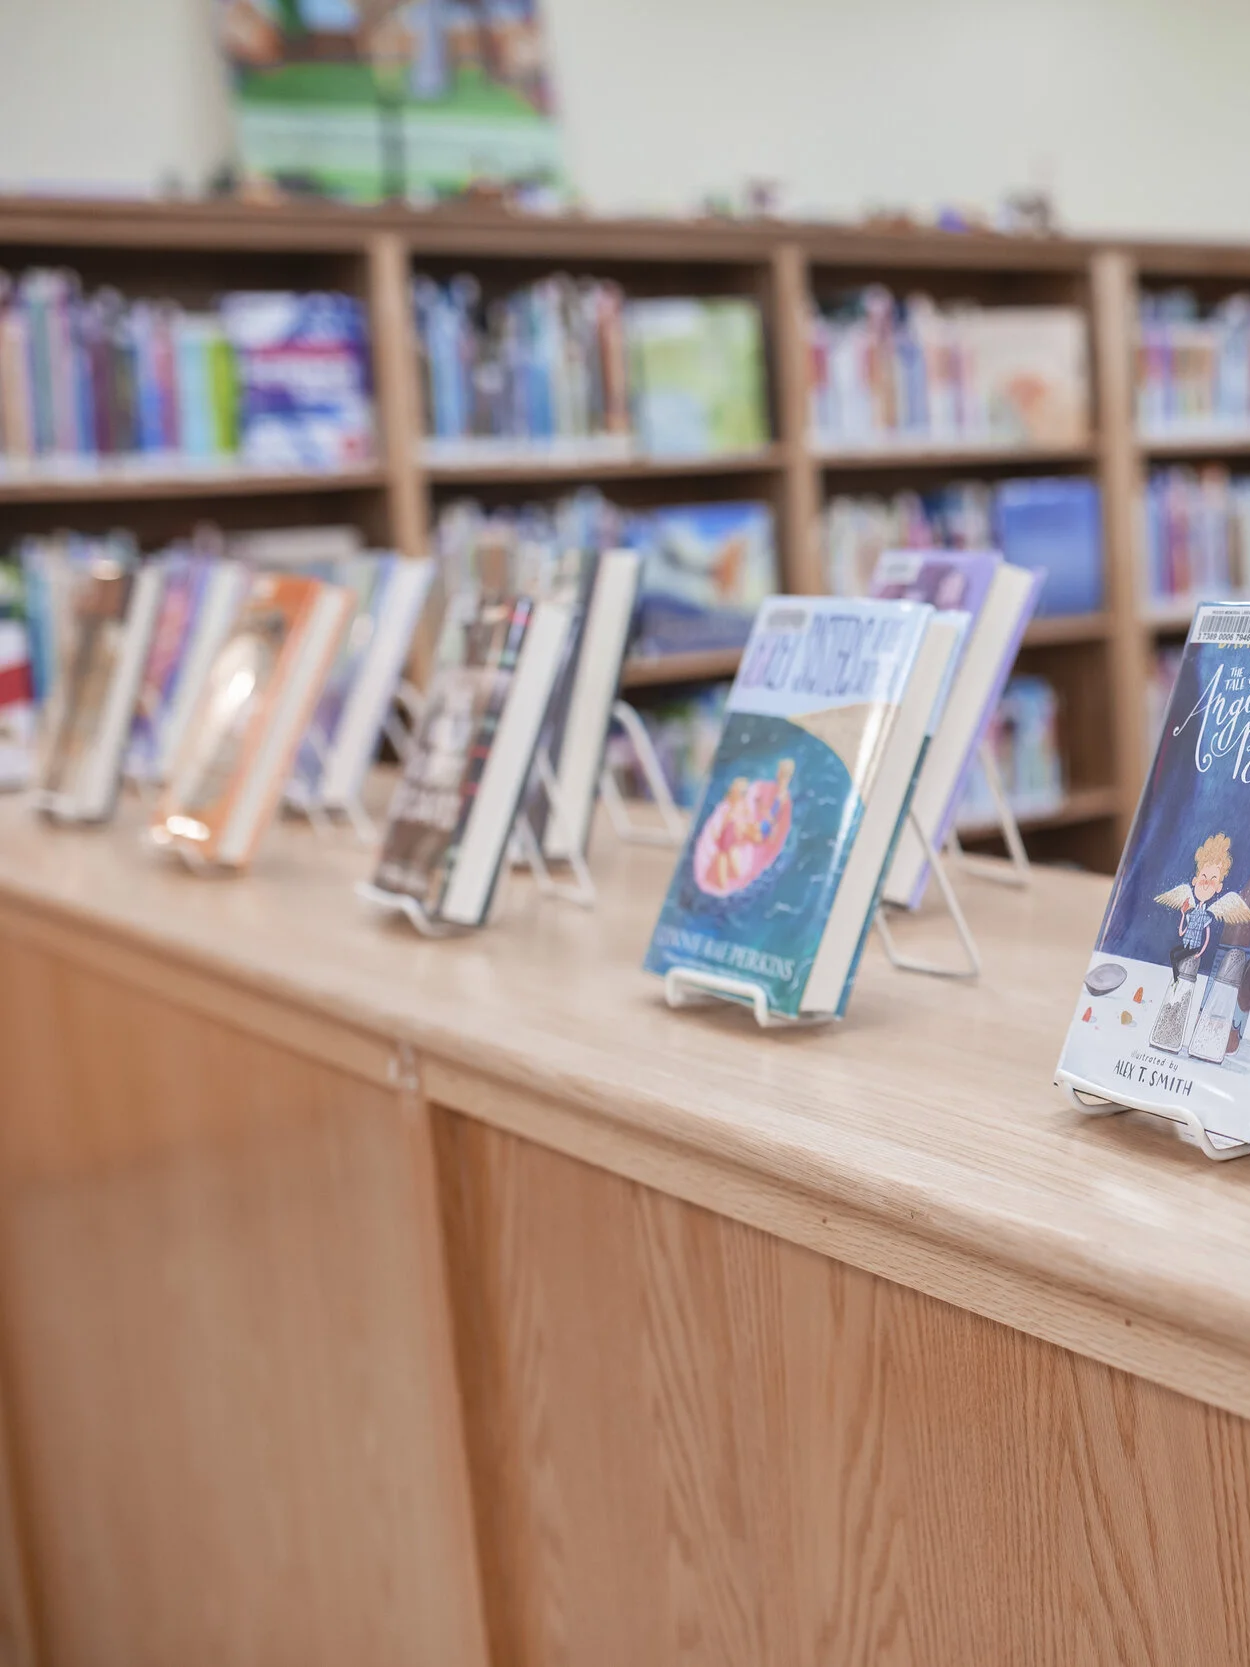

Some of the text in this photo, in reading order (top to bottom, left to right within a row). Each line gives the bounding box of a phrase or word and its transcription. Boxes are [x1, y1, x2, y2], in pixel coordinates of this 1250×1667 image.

[1218, 633, 1234, 641] 0006
[1230, 666, 1245, 677] THE
[1224, 677, 1246, 691] TALE
[1169, 1060, 1179, 1072] by
[1113, 1059, 1193, 1096] ALEX T. SMITH
